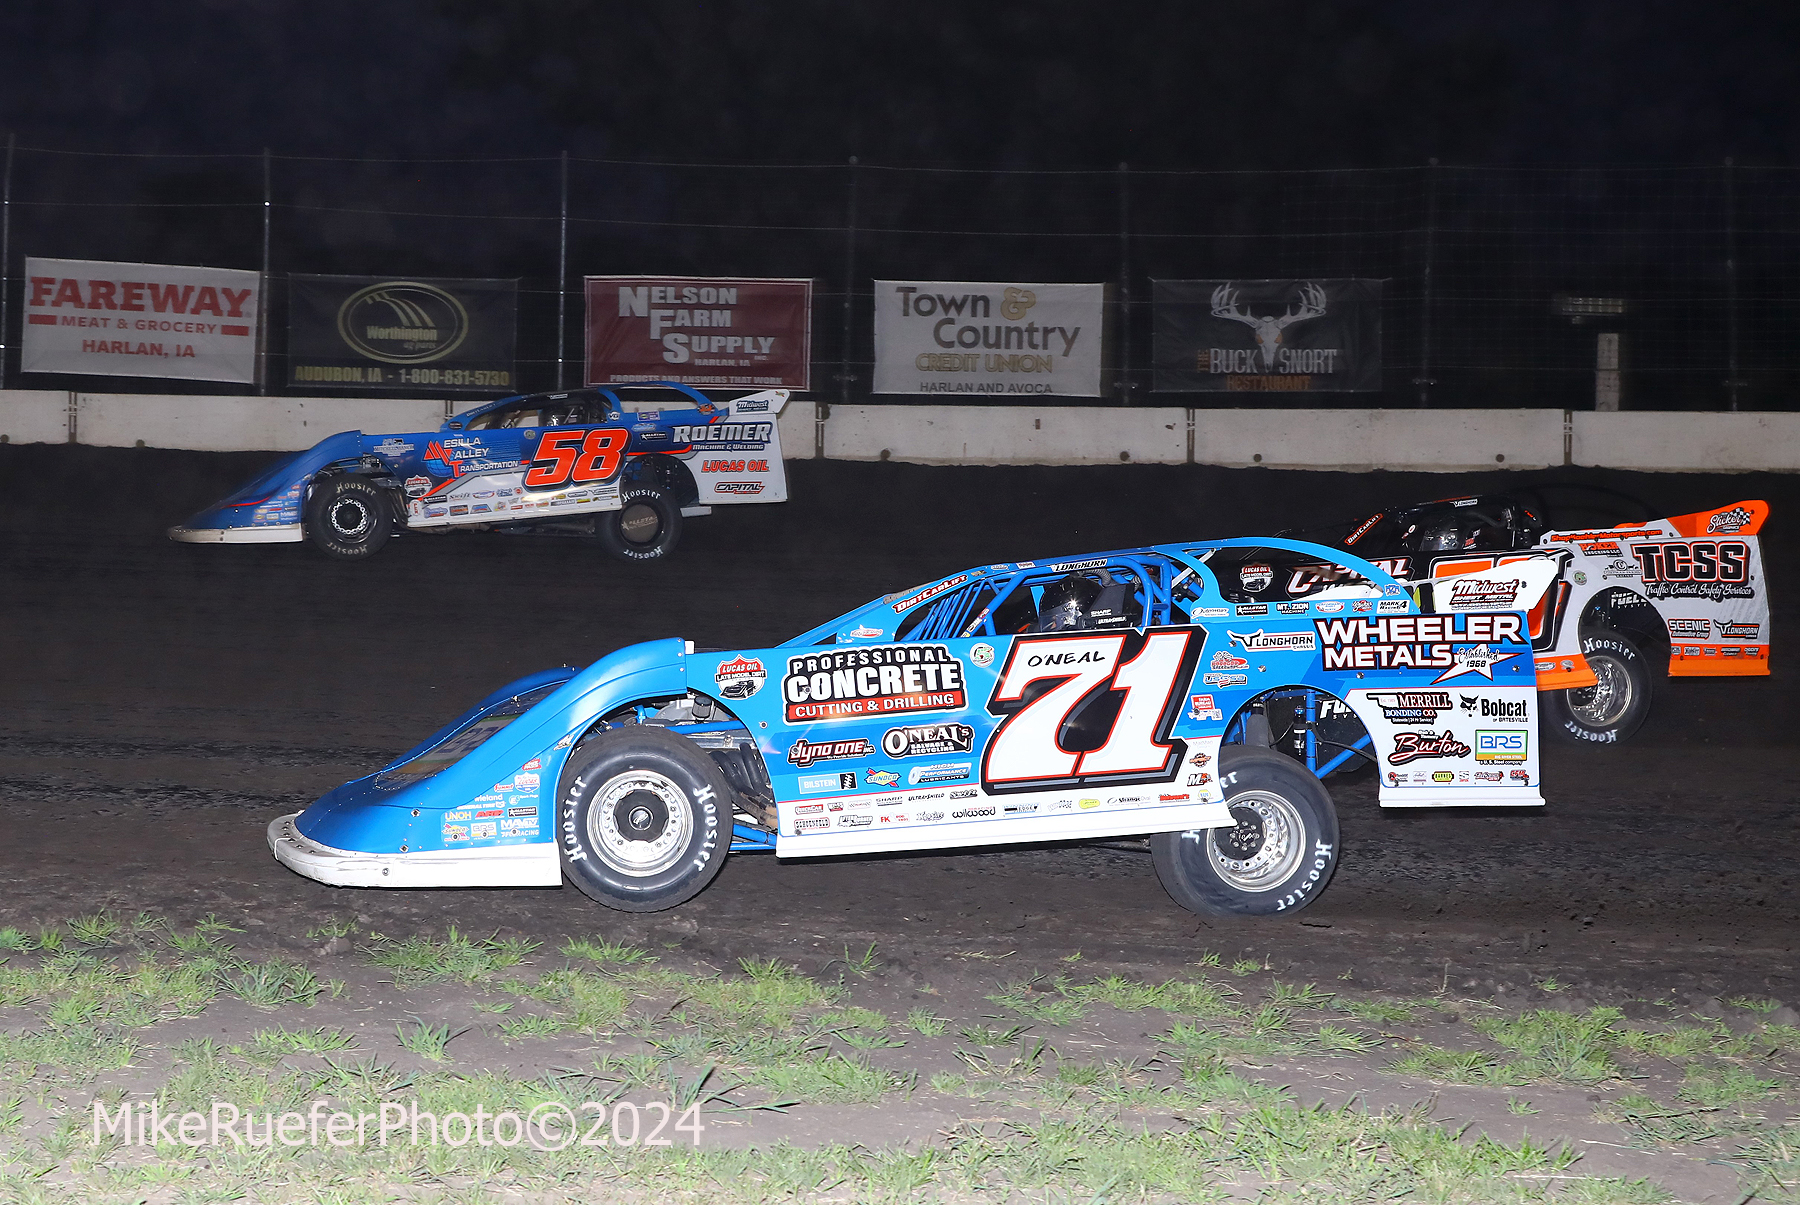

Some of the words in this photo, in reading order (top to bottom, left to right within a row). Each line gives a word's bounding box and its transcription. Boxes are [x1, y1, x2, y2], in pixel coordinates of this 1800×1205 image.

[30, 276, 252, 317] FAREWAY
[618, 286, 738, 317] NELSON
[895, 286, 990, 318] Town
[1000, 286, 1036, 321] &
[61, 315, 111, 329] MEAT
[117, 318, 128, 330] &
[135, 320, 217, 334] GROCERY
[649, 309, 732, 340] FARM
[366, 326, 438, 342] Worthington
[933, 316, 1081, 358] Country
[82, 339, 169, 359] HARLAN,
[176, 344, 196, 358] IA
[662, 332, 775, 364] SUPPLY
[694, 358, 738, 367] HARLAN,
[915, 353, 980, 372] CREDIT
[984, 354, 1053, 374] UNION
[1210, 348, 1259, 374] BUCK
[1279, 347, 1337, 374] SNORT
[295, 366, 365, 384] AUDUBON,
[368, 367, 382, 383] IA
[610, 374, 660, 383] PRODUCTS
[682, 375, 727, 384] ANSWERS
[728, 376, 751, 384] THAT
[753, 376, 783, 385] WORK
[1226, 375, 1312, 391] RESTAURANT
[919, 382, 973, 393] HARLAN
[977, 382, 1003, 393] AND
[1009, 383, 1053, 394] AVOCA
[673, 423, 771, 443] ROEMER
[525, 428, 629, 487] 58
[701, 459, 745, 472] LUCAS
[747, 459, 770, 472] OIL
[448, 460, 519, 478] TRANSPORTATION
[336, 481, 377, 495] Hoosier
[622, 489, 661, 503] Hoosier
[715, 483, 761, 491] CAPITAL
[1632, 542, 1749, 582] TCSS
[1452, 579, 1519, 595] Midwest
[1645, 582, 1669, 597] Traffic
[1670, 582, 1697, 595] Control
[1698, 582, 1721, 599] Safety
[1722, 583, 1752, 596] Services
[1291, 602, 1309, 610] ZION
[1315, 615, 1523, 645] WHEELER
[1669, 620, 1710, 631] SCENIC
[1256, 636, 1314, 647] LONGHORN
[1583, 637, 1636, 661] Hoosier
[793, 648, 950, 675] PROFESSIONAL
[1027, 650, 1105, 668] O'NEAL
[1323, 643, 1453, 670] METALS
[1466, 660, 1487, 668] 1968
[722, 664, 746, 673] LUCAS
[746, 662, 758, 671] OIL
[716, 673, 731, 681] LATE
[787, 663, 961, 703] CONCRETE
[795, 700, 862, 718] CUTTING
[867, 698, 887, 712] &
[889, 692, 955, 710] DRILLING
[985, 630, 1193, 783] 71
[1397, 694, 1452, 708] MERRILL
[1480, 698, 1527, 717] Bobcat
[1384, 709, 1422, 717] BONDING
[1422, 709, 1436, 717] CO.
[1564, 720, 1618, 744] Hoosier
[1388, 731, 1470, 762] Burton
[1480, 735, 1523, 749] BRS
[868, 774, 898, 783] SUNOCO
[920, 768, 967, 778] PERFORMANCE
[920, 775, 966, 783] LUBRICANTS
[804, 779, 837, 789] BILSTEIN
[445, 810, 472, 821] UNOH
[564, 776, 588, 863] Hoosier
[952, 806, 996, 819] wilwood
[693, 783, 719, 872] Hoosier
[1276, 838, 1333, 911] Hoosier
